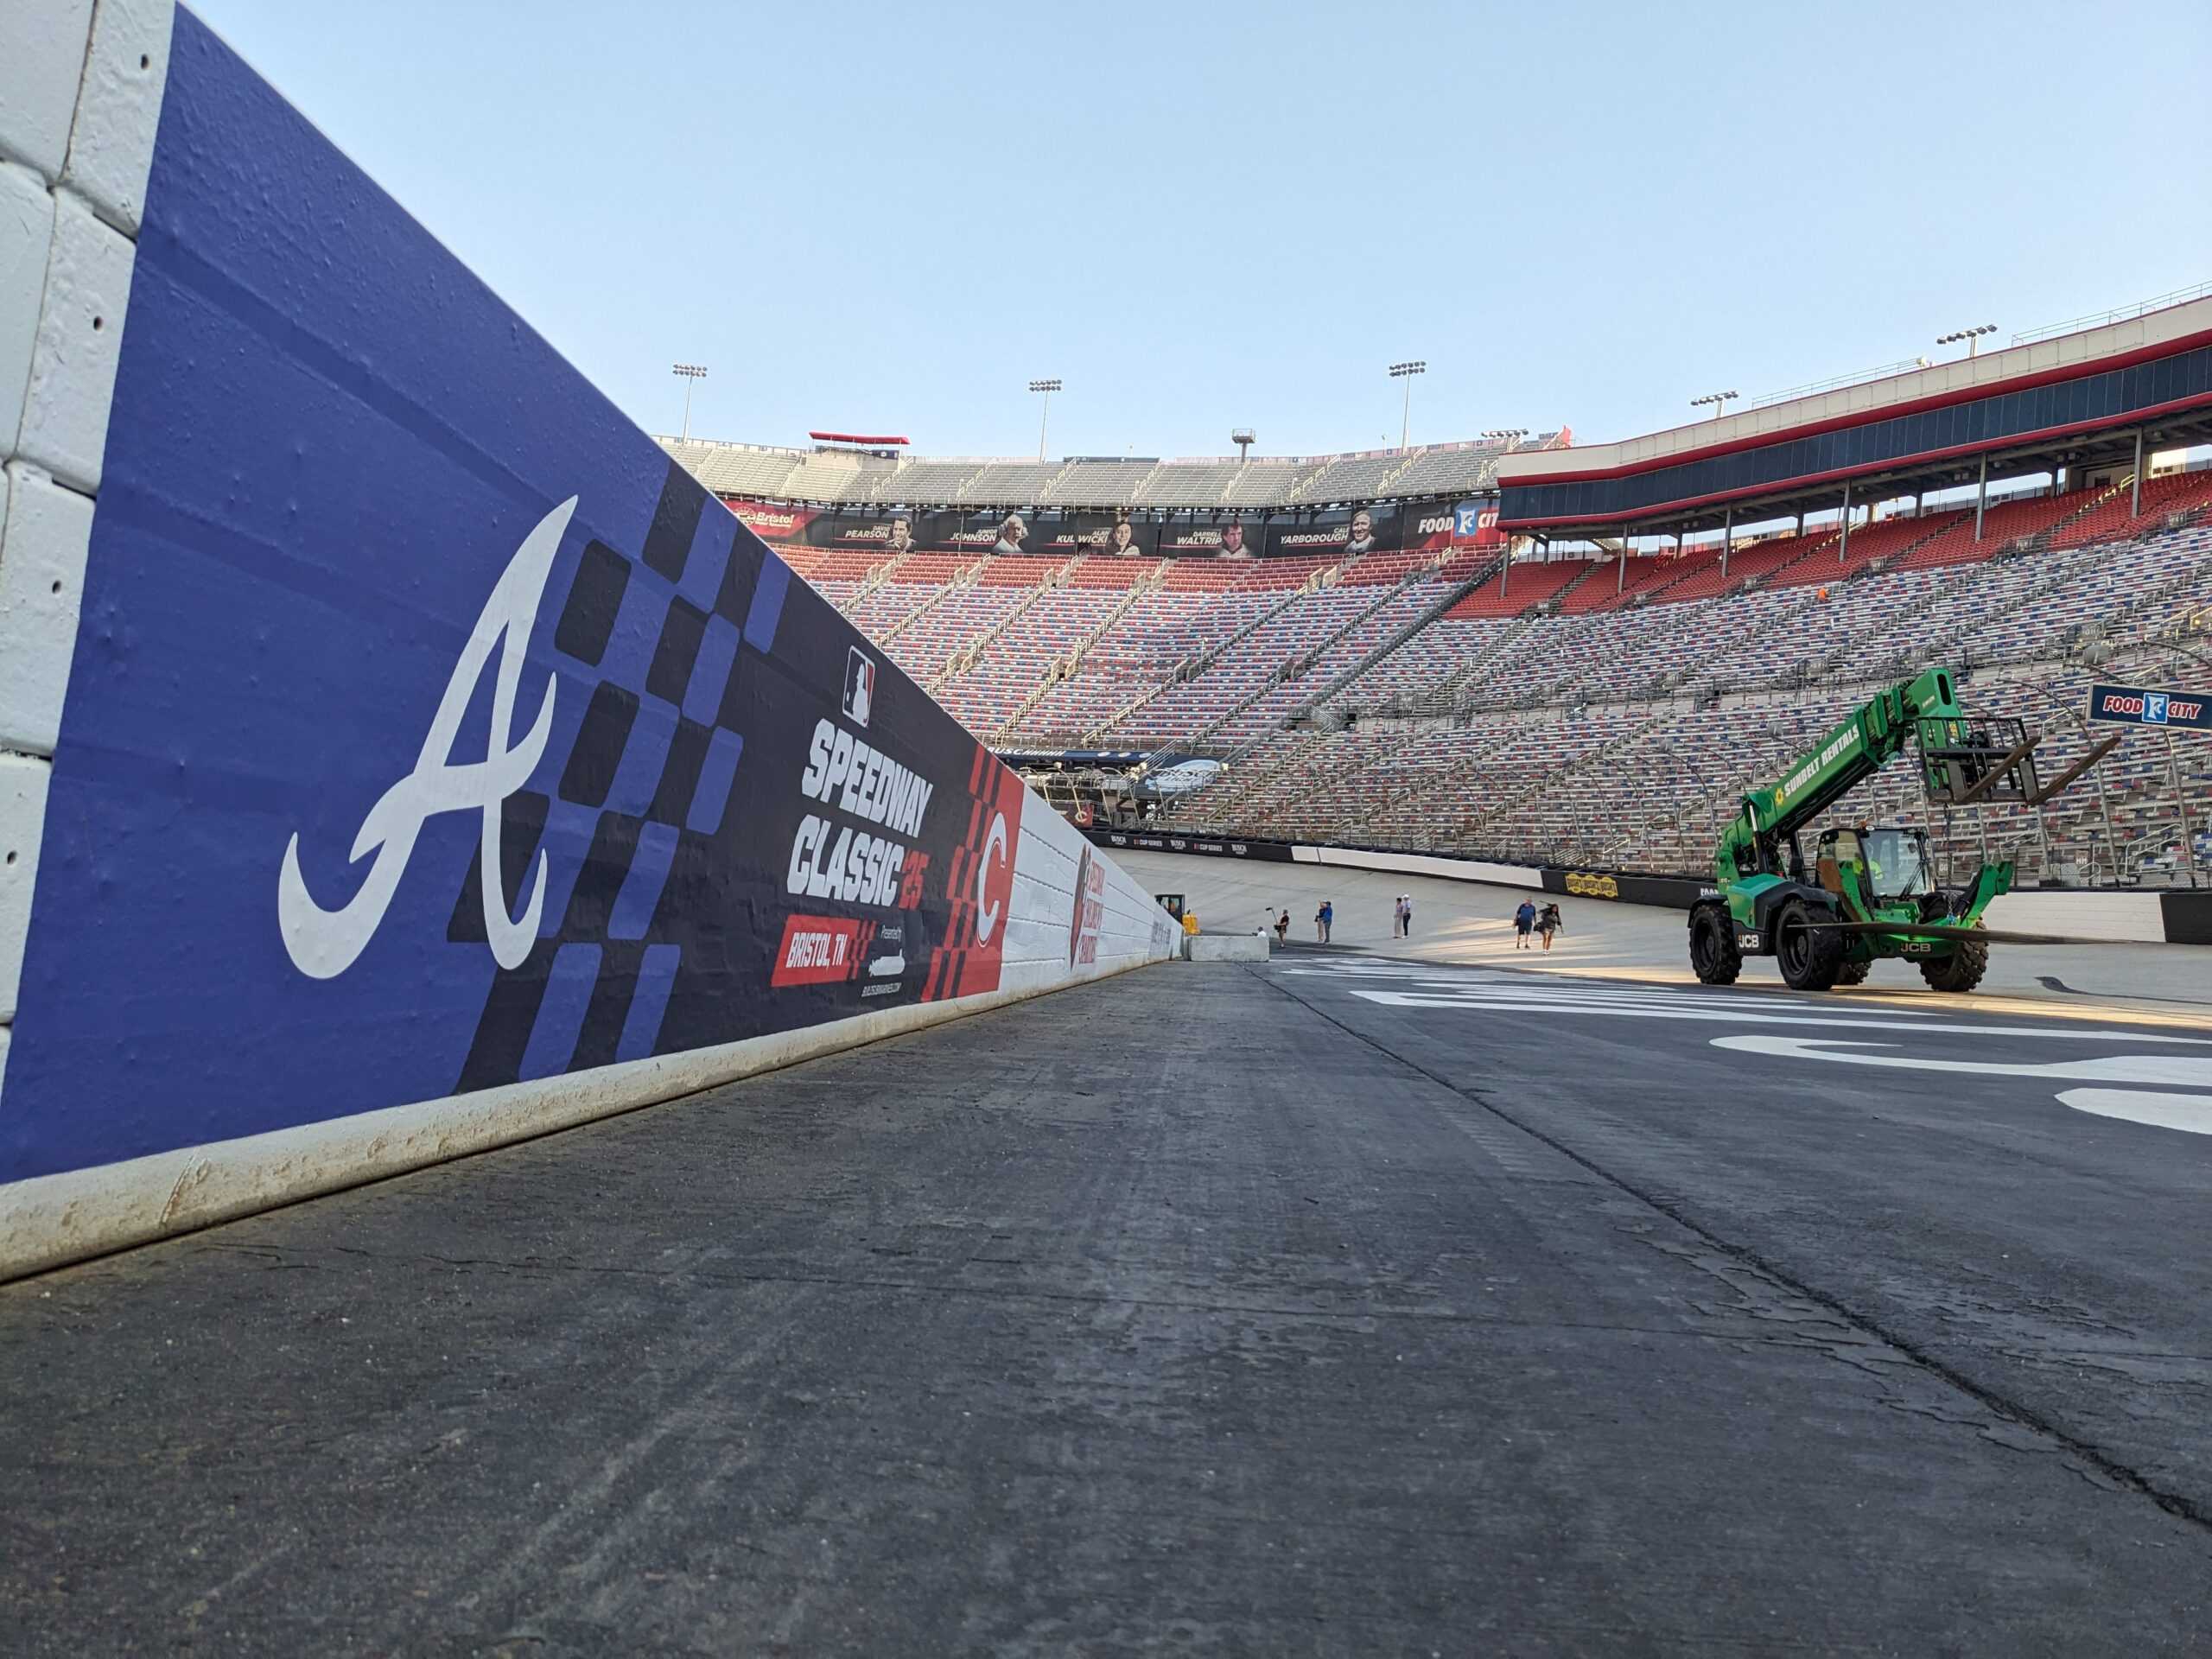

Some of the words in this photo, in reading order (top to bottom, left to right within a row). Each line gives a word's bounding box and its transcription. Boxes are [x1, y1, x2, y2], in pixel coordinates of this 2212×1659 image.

[755, 512, 795, 524] Bristol
[1478, 512, 1499, 529] CIT
[1418, 517, 1455, 534] FOOD
[845, 530, 889, 538] PEARSON
[950, 532, 996, 542] JOHNSON
[1280, 532, 1348, 544] YARBOROUGH
[1177, 537, 1223, 545] WALTRIP
[2102, 696, 2143, 714] FOOD
[2167, 702, 2202, 719] CITY
[1784, 757, 1820, 797] SUNBELT
[1821, 724, 1860, 766] RENTALS
[802, 718, 933, 838] SPEEDWAY
[1111, 836, 1127, 844] BUSCH
[1231, 844, 1247, 853] BUSCH
[787, 814, 905, 907] CLASSIC
[1738, 935, 1759, 948] JCB
[1901, 944, 1931, 952] JCB
[785, 932, 831, 971] BRISTOL,
[832, 934, 848, 966] TN
